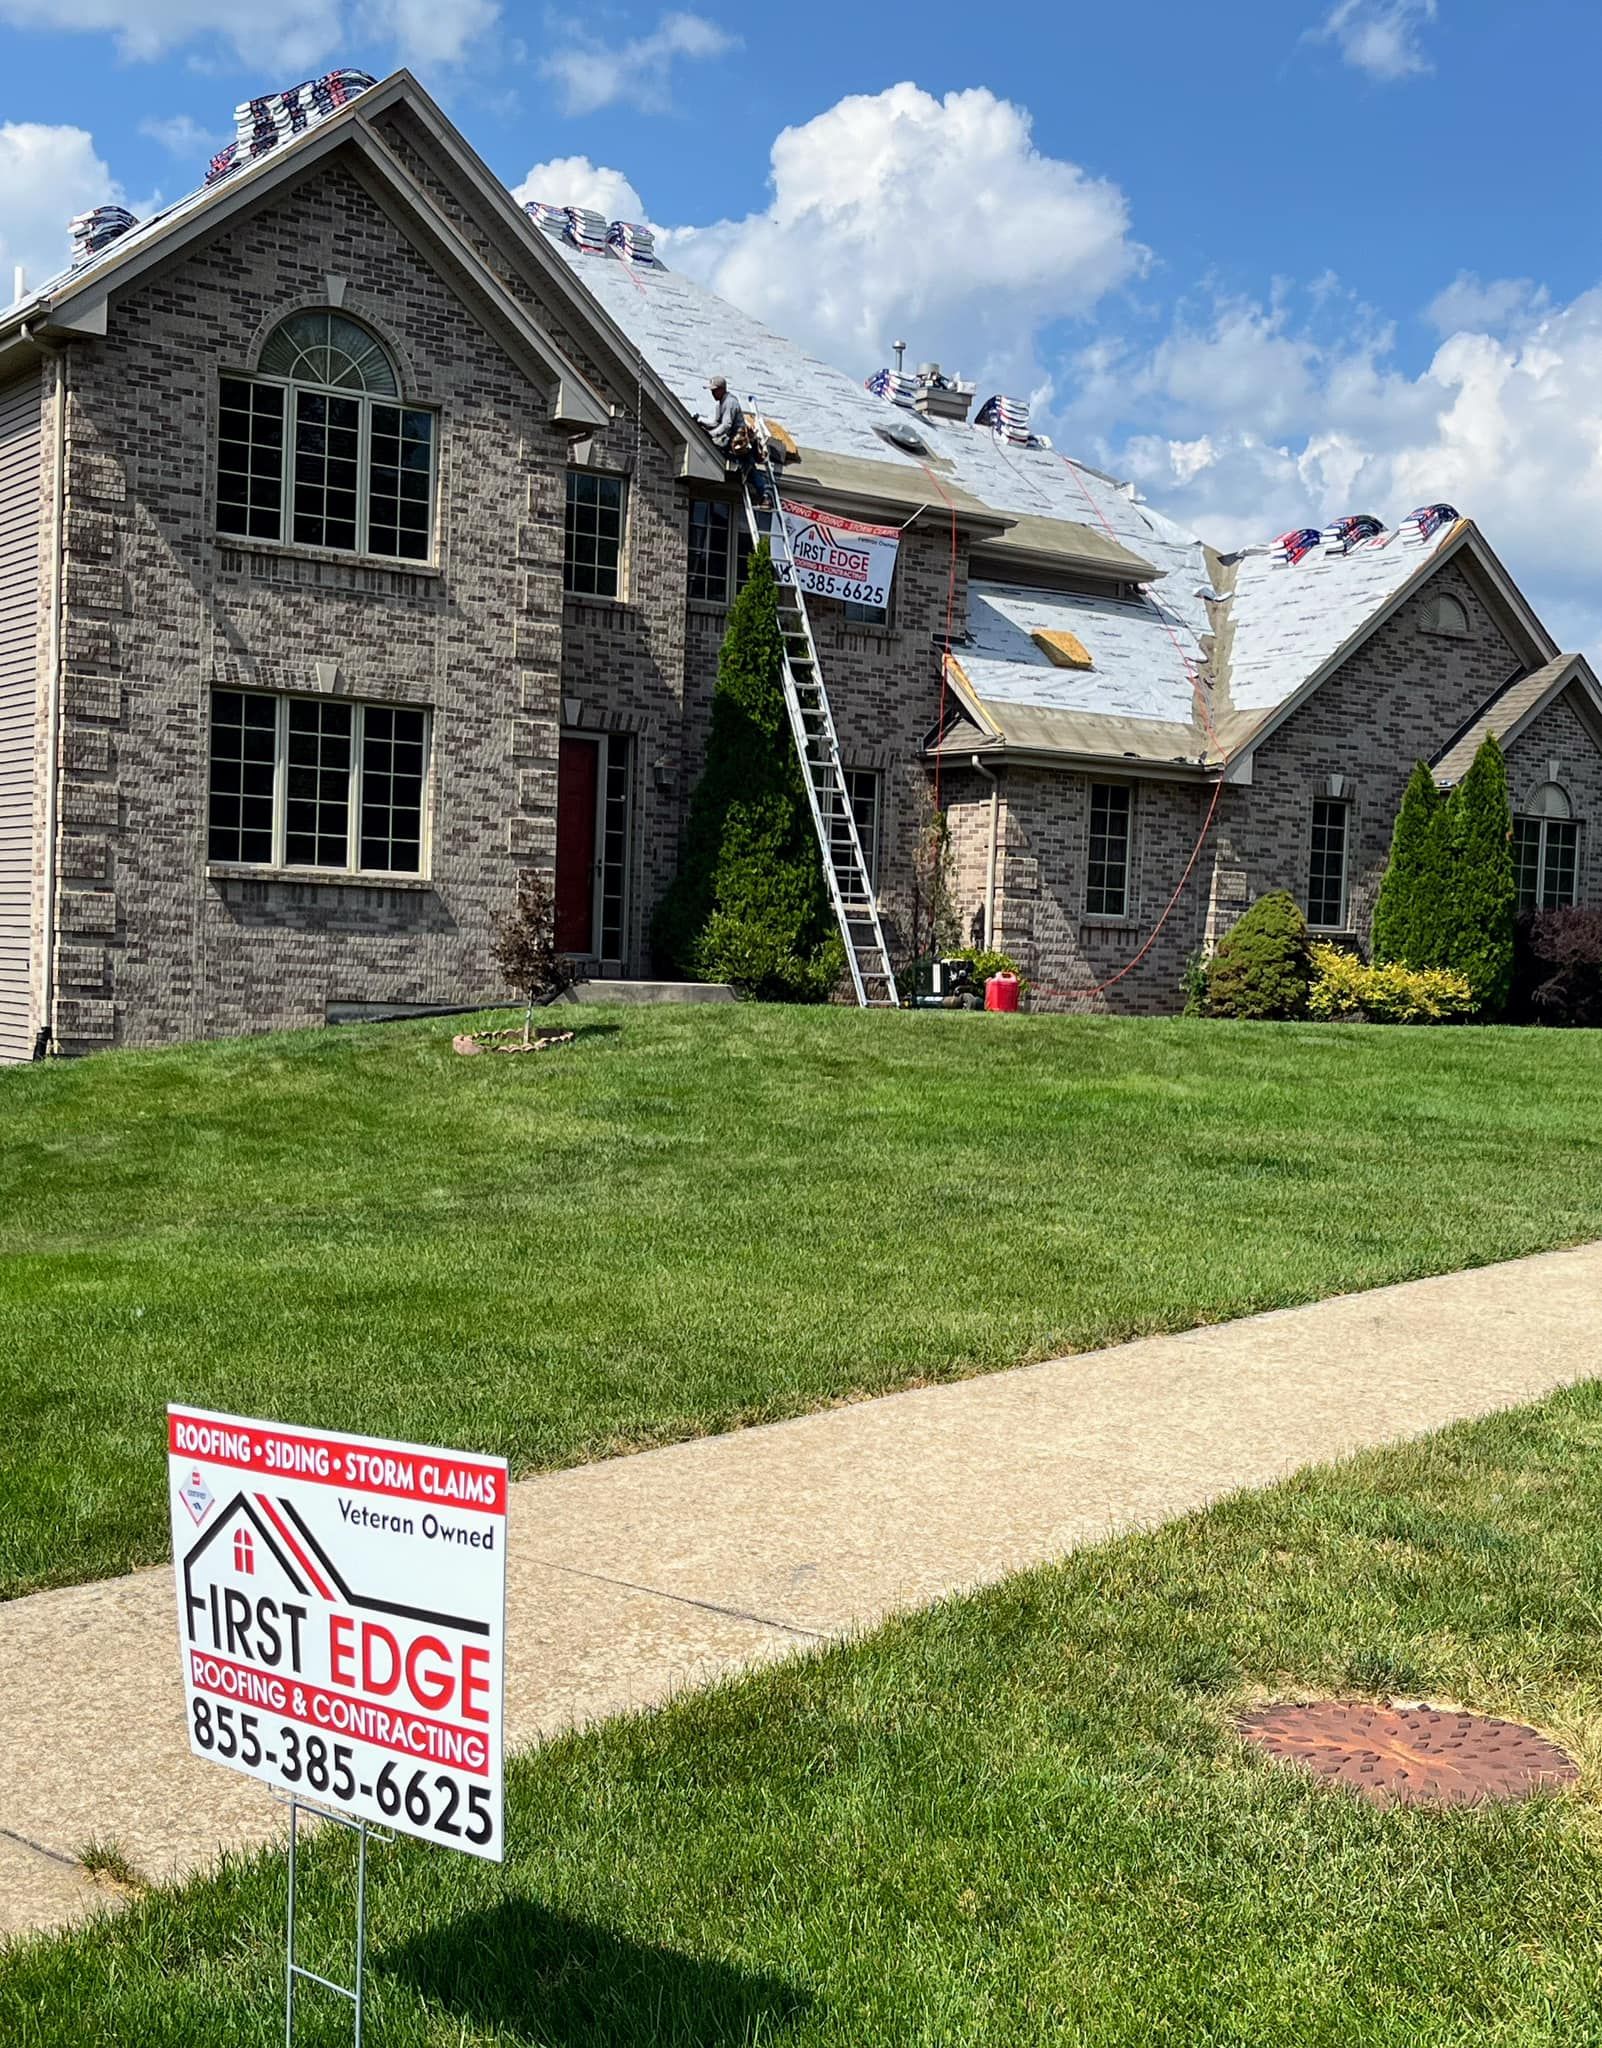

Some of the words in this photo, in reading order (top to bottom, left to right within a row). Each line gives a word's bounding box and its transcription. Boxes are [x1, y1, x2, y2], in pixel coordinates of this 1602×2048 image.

[781, 501, 812, 517] OOFING
[793, 541, 826, 562] FIRST
[829, 550, 870, 572] EDGE
[175, 1422, 251, 1459] ROOFING
[265, 1440, 331, 1476] SIDING
[345, 1455, 415, 1491] STORM
[420, 1471, 497, 1505] CLAIMS
[338, 1498, 414, 1535] Veteran
[422, 1514, 494, 1550] Owned
[186, 1583, 308, 1673] FIRST
[329, 1614, 490, 1724] EDGE
[192, 1653, 287, 1711] ROOFING
[291, 1688, 308, 1718] &
[312, 1694, 487, 1767] CONTRACTING
[192, 1697, 494, 1846] 855-385-6625
